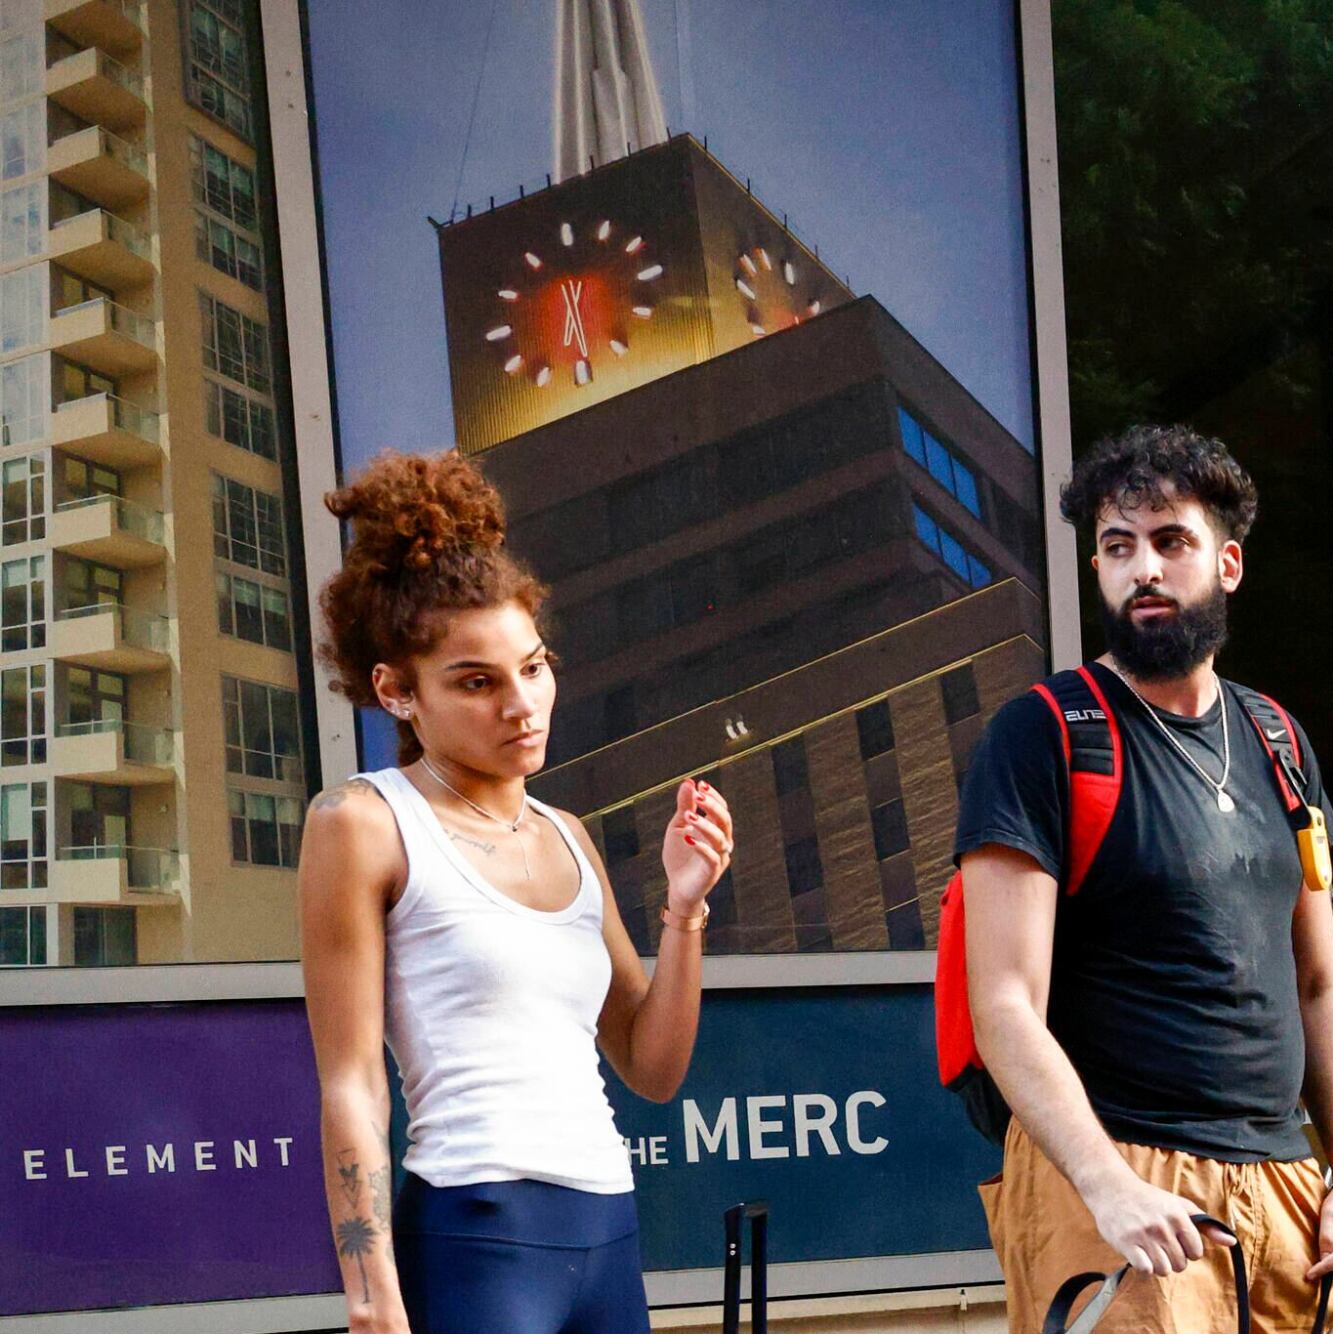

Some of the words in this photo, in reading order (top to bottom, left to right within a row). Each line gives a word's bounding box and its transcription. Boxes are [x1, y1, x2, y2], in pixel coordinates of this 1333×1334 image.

[624, 1136, 669, 1166] HE
[682, 1090, 889, 1163] MERC
[23, 1137, 293, 1180] ELEMENT
